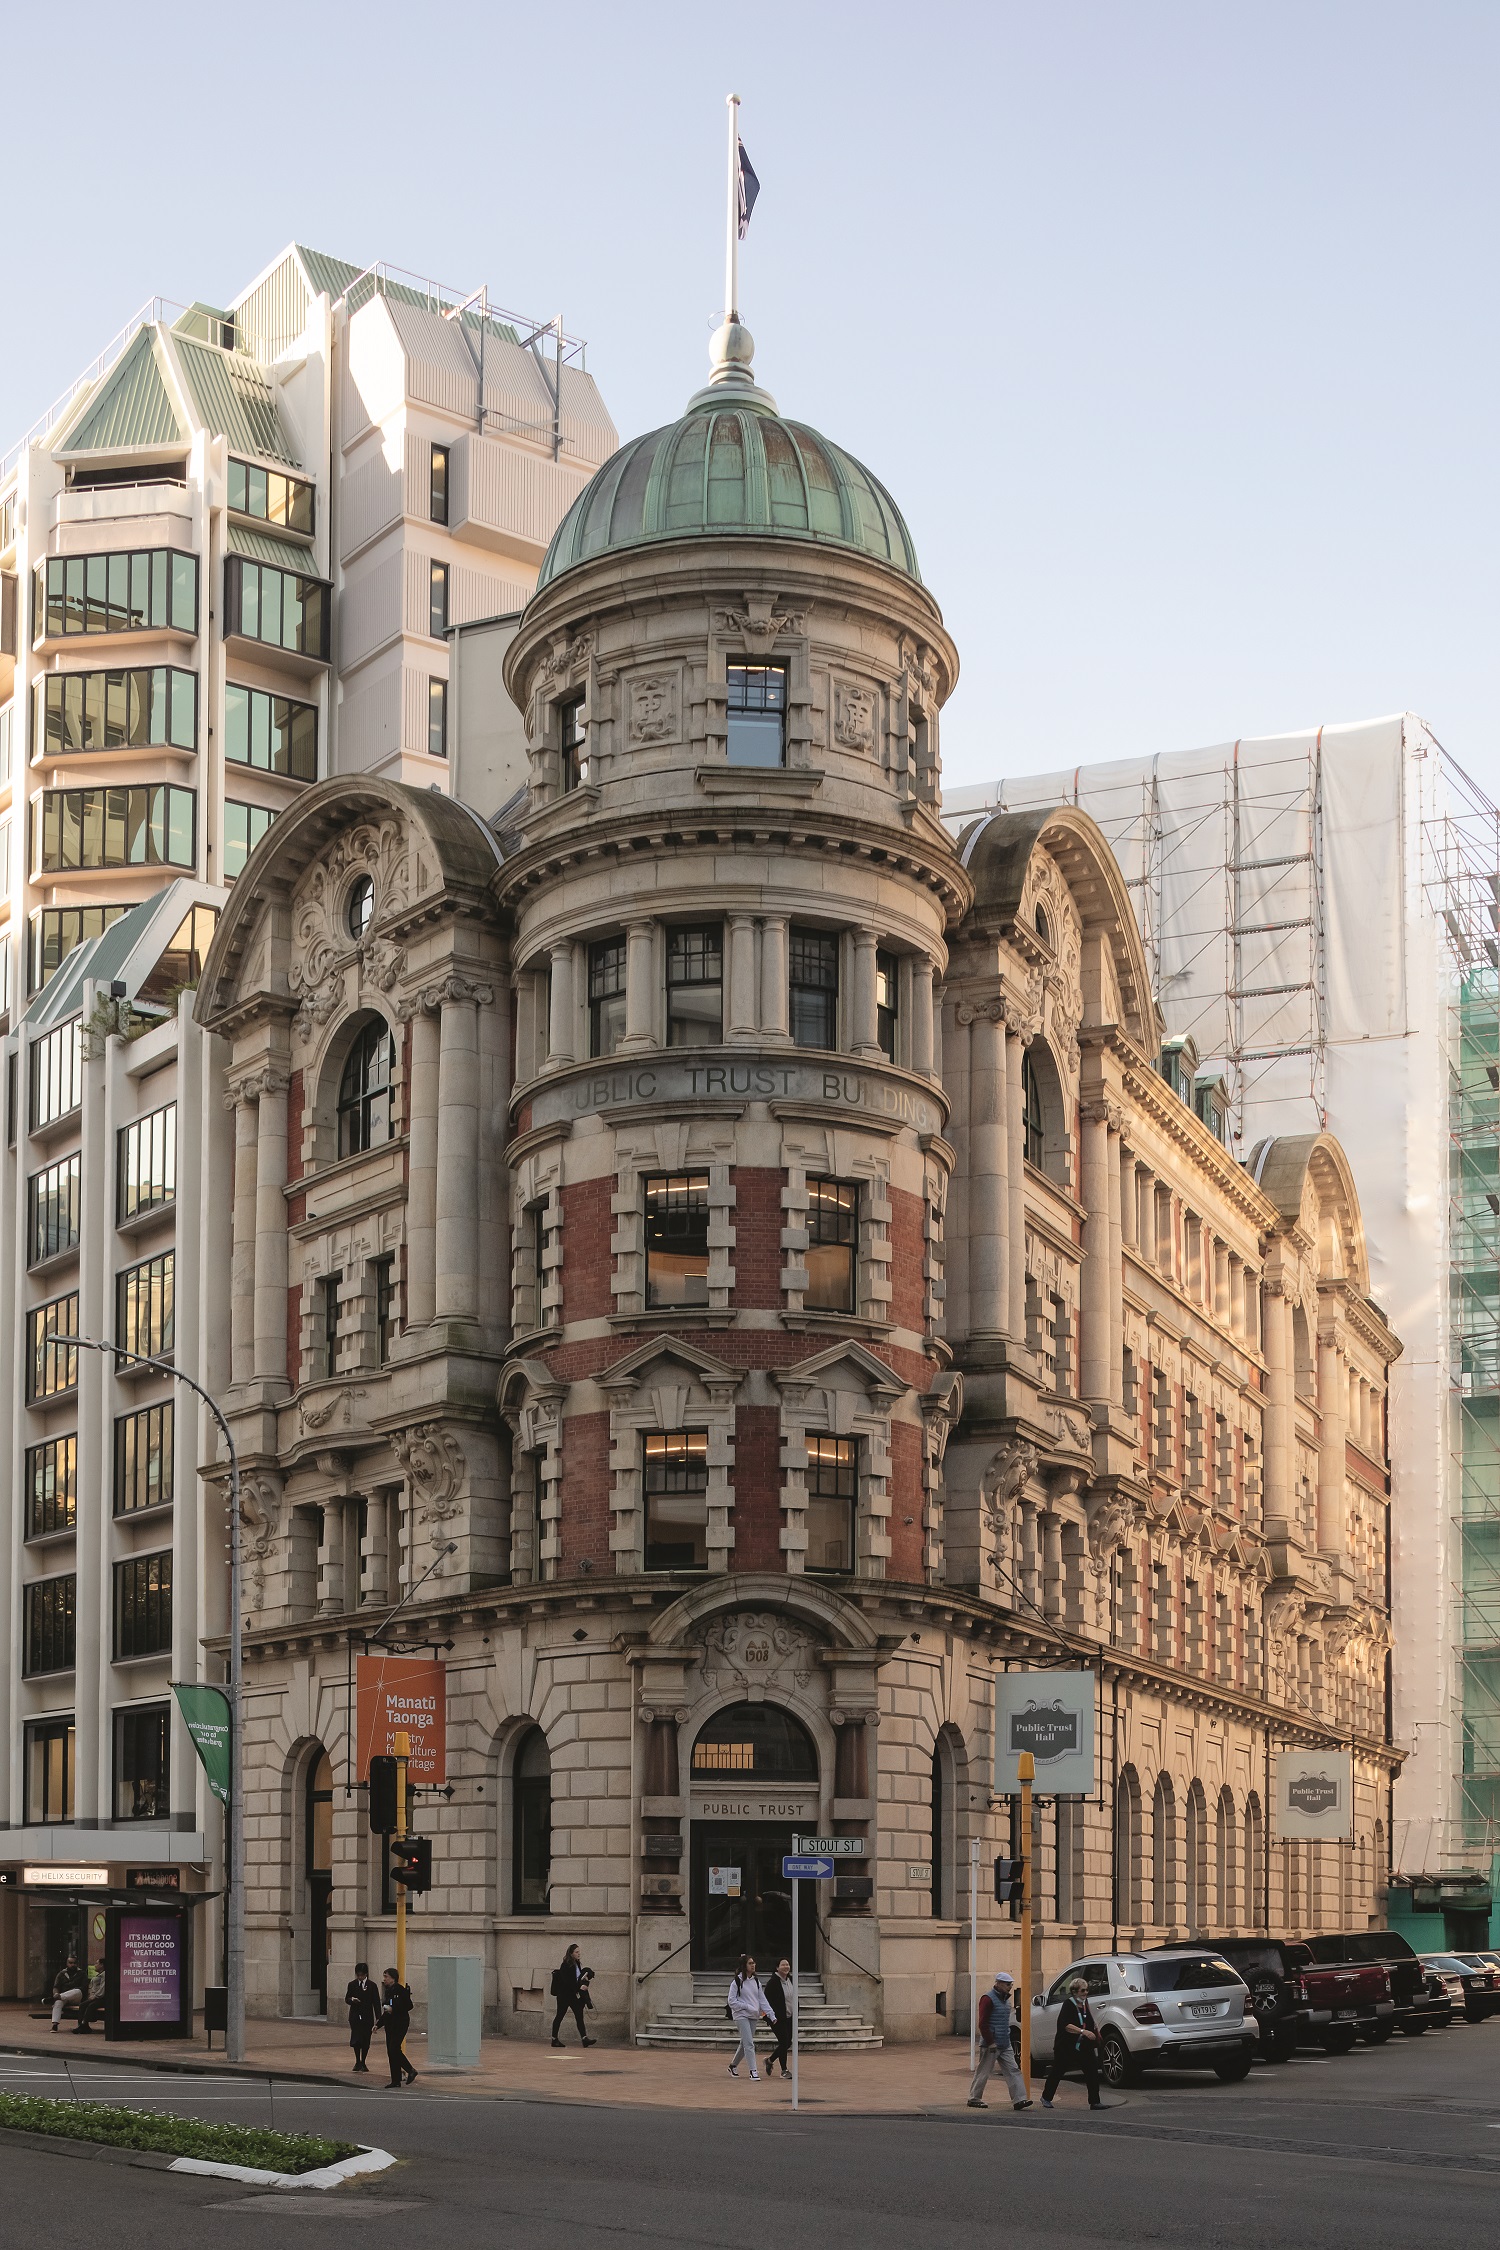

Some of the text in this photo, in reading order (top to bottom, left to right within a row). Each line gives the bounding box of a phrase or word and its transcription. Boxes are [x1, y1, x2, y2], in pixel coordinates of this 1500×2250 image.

[685, 1066, 796, 1096] TRUST
[822, 1073, 927, 1127] BUILDING
[746, 1640, 770, 1650] A.D.
[745, 1649, 770, 1662] 1908
[386, 1694, 436, 1710] Manatū
[386, 1710, 434, 1729] Taonga
[1016, 1723, 1073, 1732] Public Trust
[386, 1731, 425, 1747] Mstry
[1035, 1733, 1055, 1741] Hall
[409, 1745, 437, 1757] ulture
[408, 1757, 435, 1772] ritage
[703, 1803, 804, 1816] PUBLIC TRUST
[808, 1840, 856, 1852] STOUT ST
[41, 1872, 64, 1880] HELIX
[133, 1976, 167, 1984] INTERNET.
